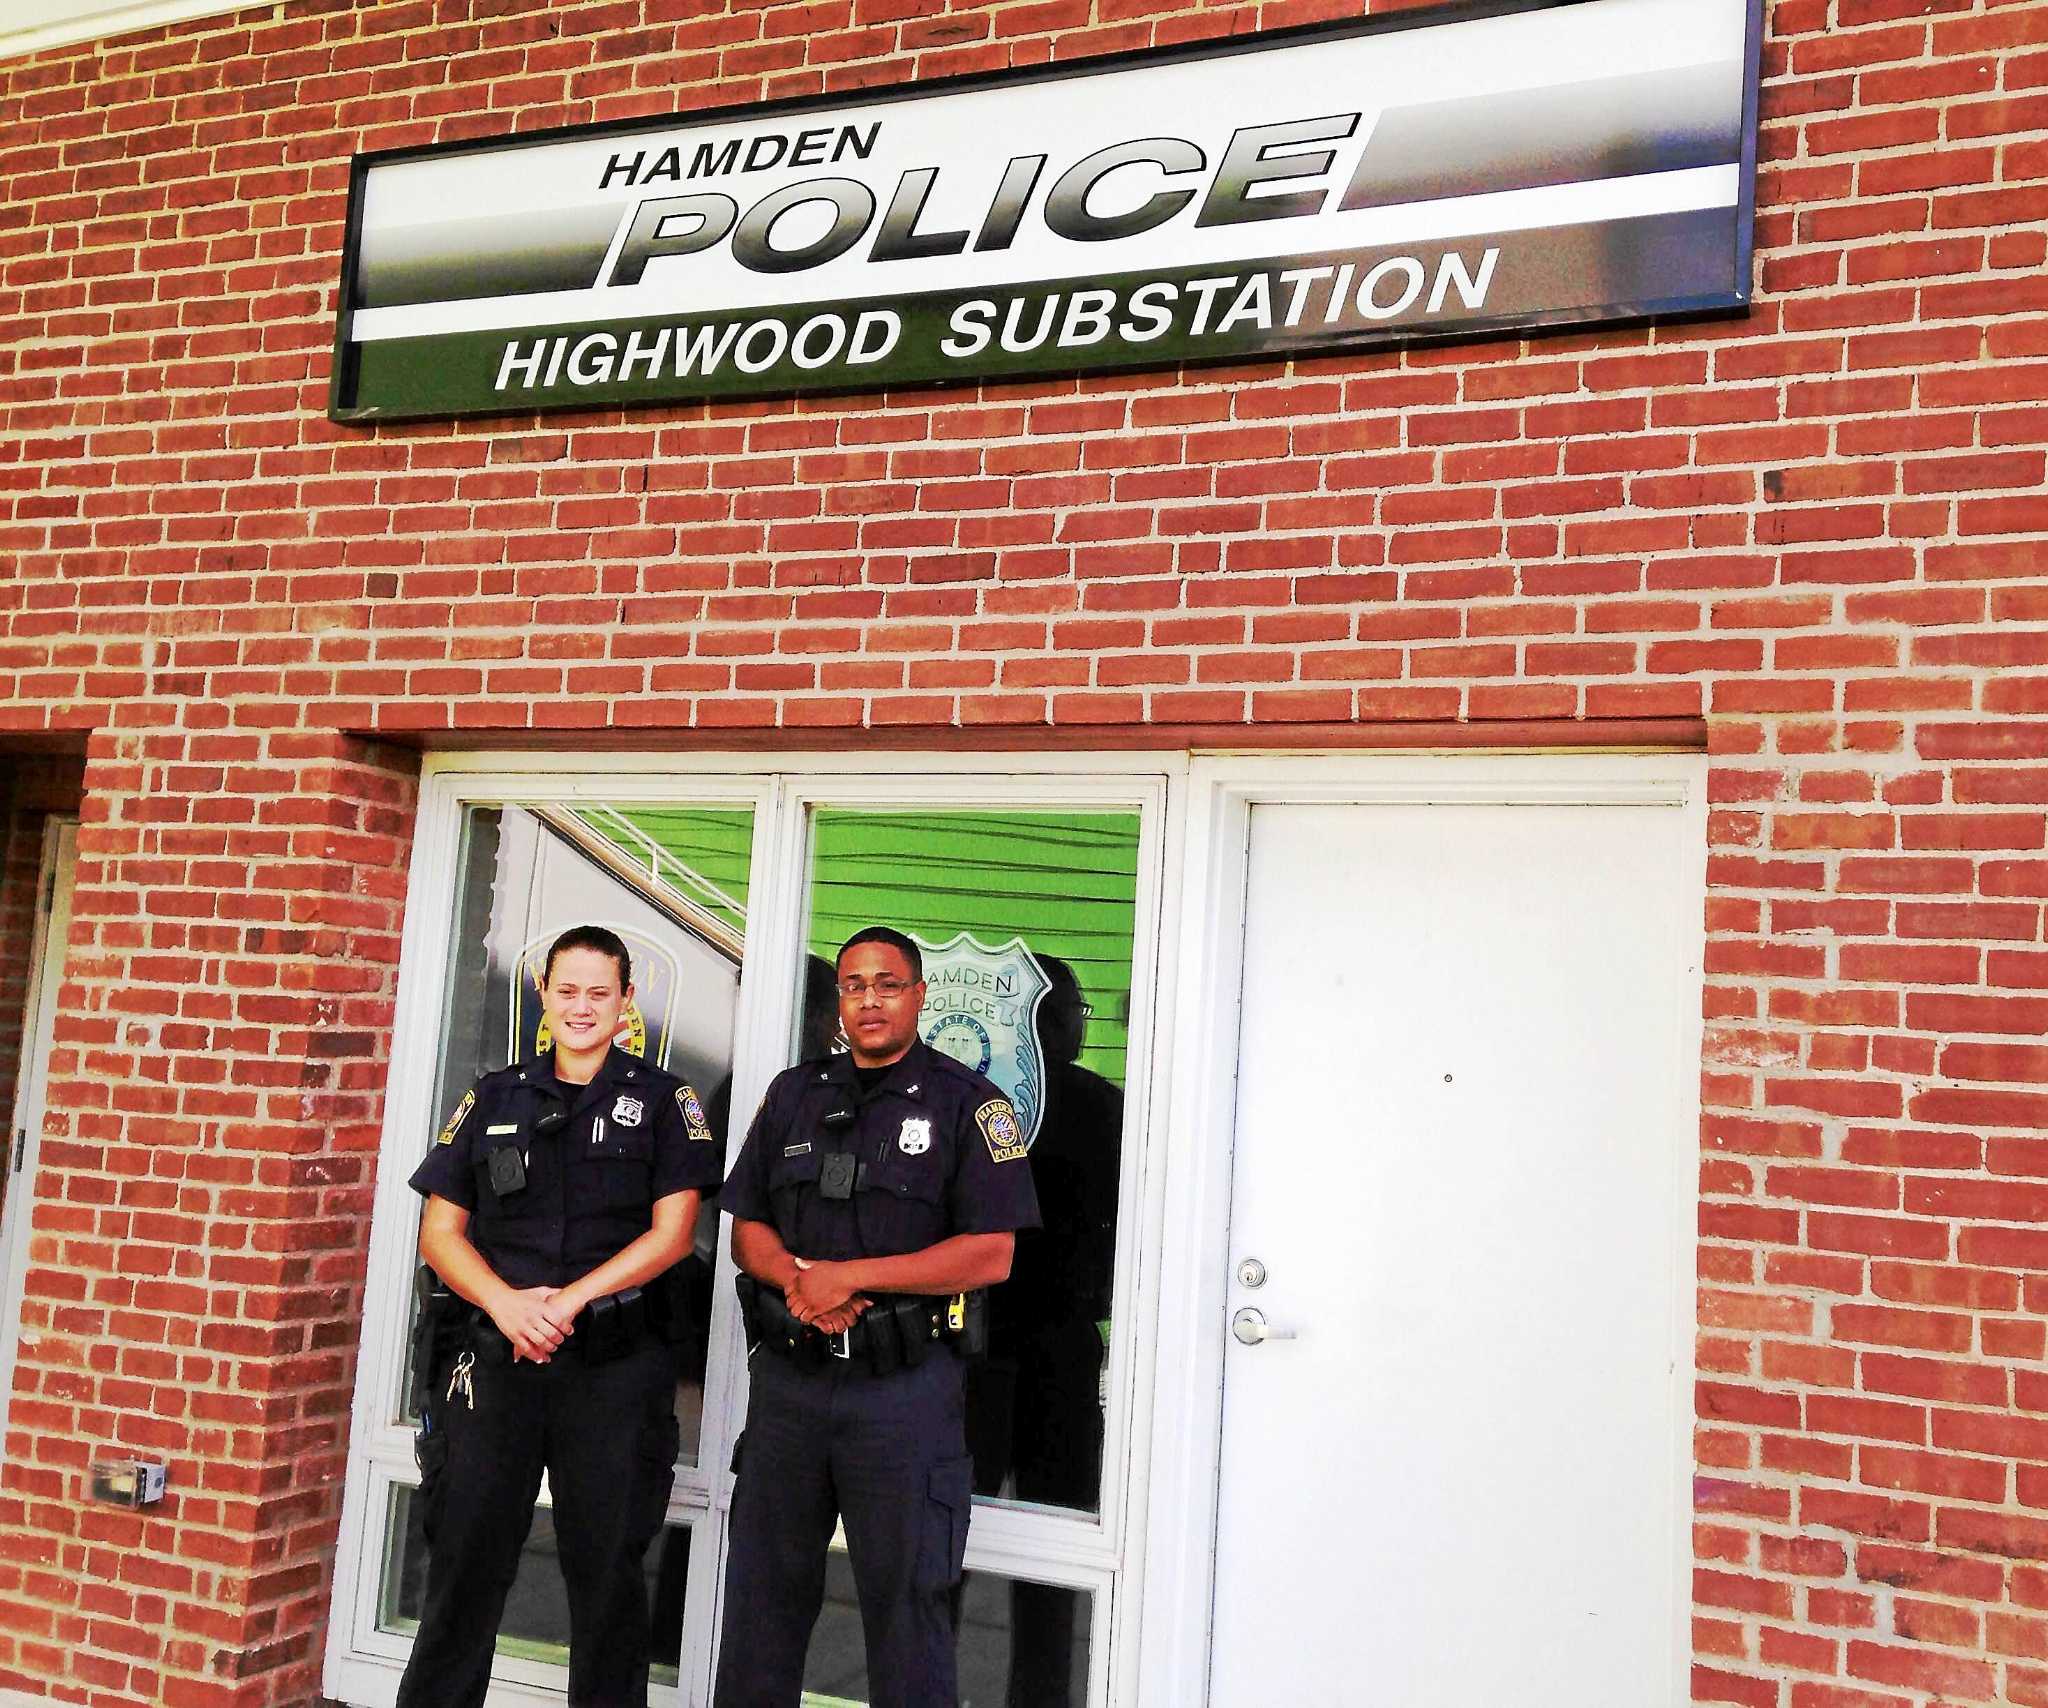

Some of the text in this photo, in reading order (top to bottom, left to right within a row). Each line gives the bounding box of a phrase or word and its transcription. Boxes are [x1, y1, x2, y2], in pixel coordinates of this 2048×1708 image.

[599, 121, 882, 190] HAMDEN
[607, 112, 1362, 287] POLICE
[494, 247, 1499, 391] HIGHWOOD SUBSTATION
[927, 967, 1012, 993] AMDEN
[919, 992, 997, 1020] POLICE
[929, 1015, 969, 1036] STATE
